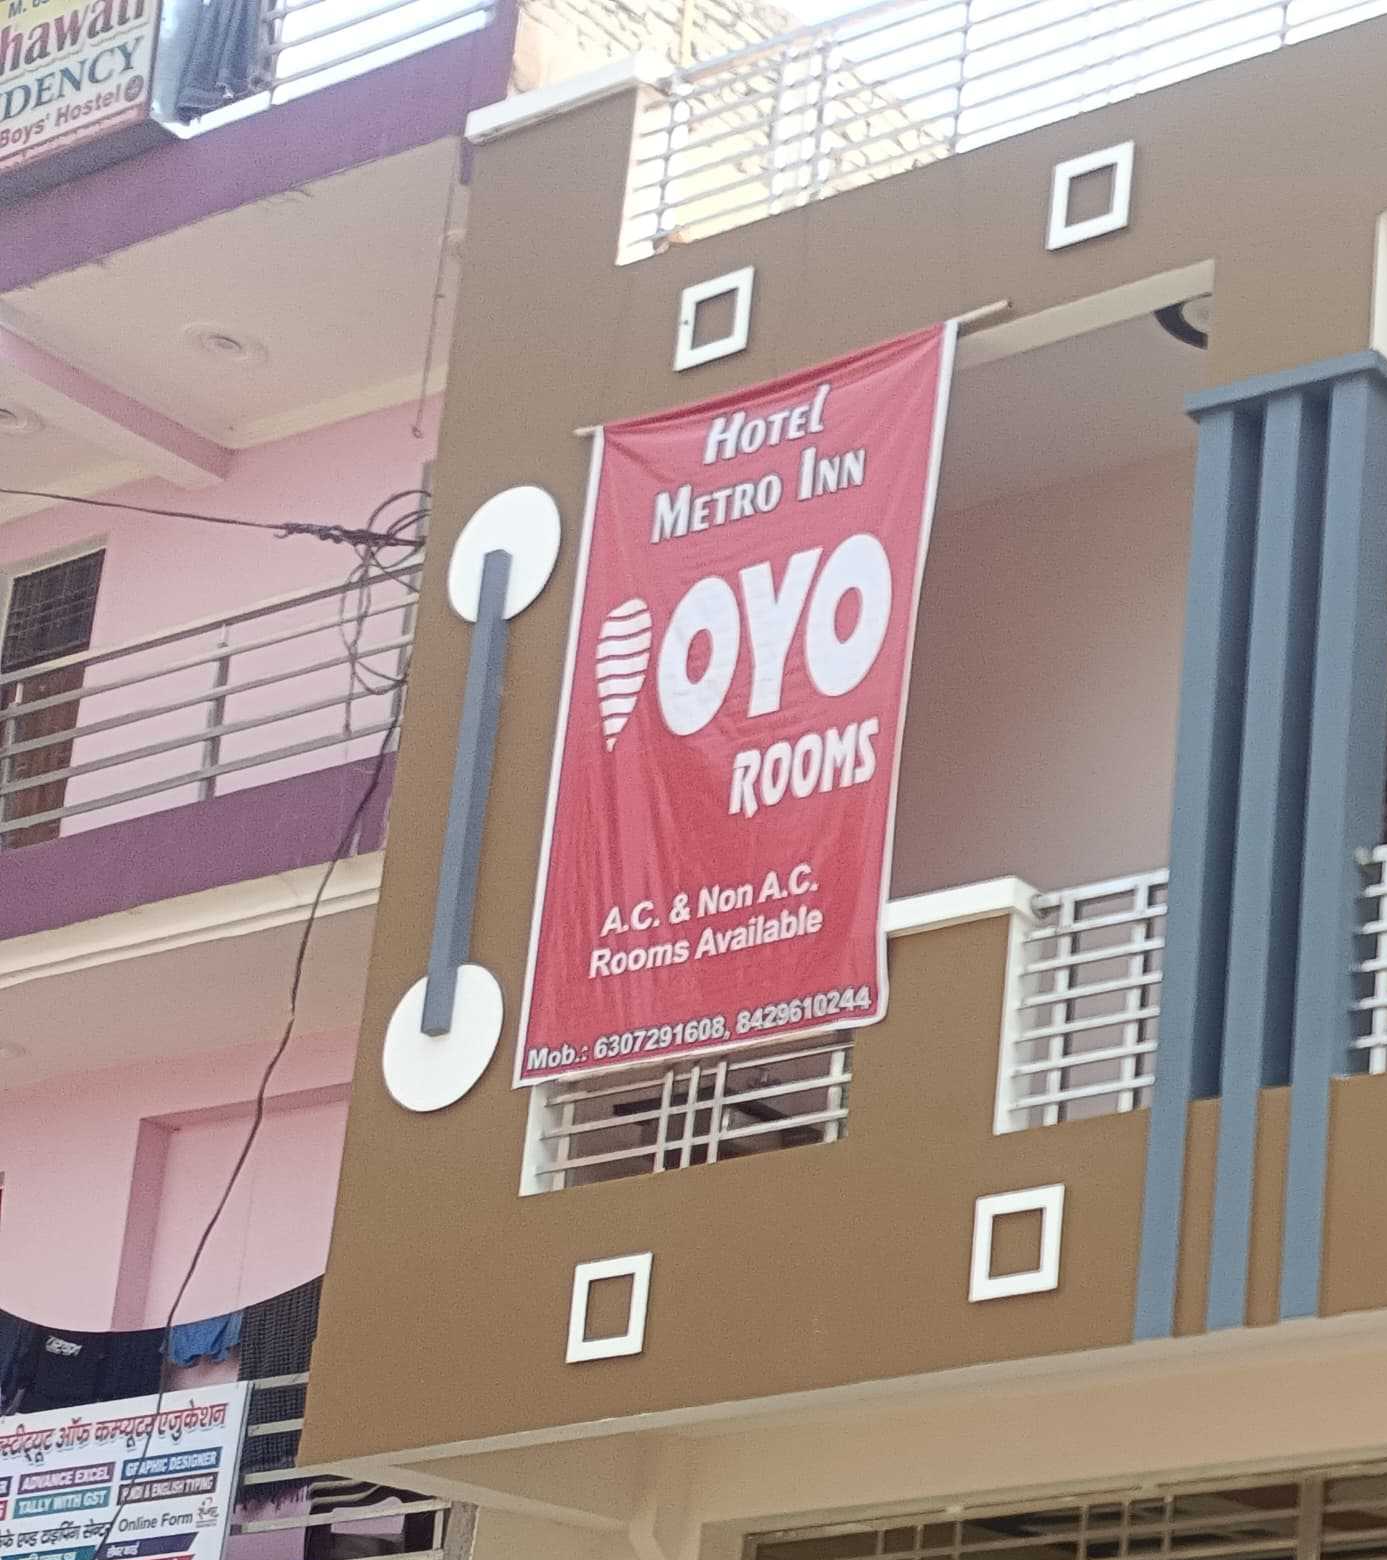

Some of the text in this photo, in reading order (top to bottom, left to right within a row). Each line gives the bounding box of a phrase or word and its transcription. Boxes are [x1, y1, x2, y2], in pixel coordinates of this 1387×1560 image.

[54, 83, 122, 127] Hostel
[650, 447, 866, 544] METRO INN
[657, 533, 892, 736] OYO
[728, 717, 879, 818] ROOMS
[600, 862, 819, 937] A.C. & Non A.C.
[588, 906, 823, 979] Rooms Available
[593, 1016, 731, 1059] 6307291608,
[736, 985, 872, 1034] 8429610244
[20, 1472, 74, 1491] ADVANCE
[75, 1466, 110, 1484] EXCEL
[152, 1479, 184, 1497] ENGLISH
[185, 1475, 213, 1492] TYPING
[170, 1451, 217, 1471] DESIGNER
[18, 1490, 107, 1513] TALLY WITH GST
[119, 1513, 157, 1533] Online
[161, 1512, 193, 1528] Form
